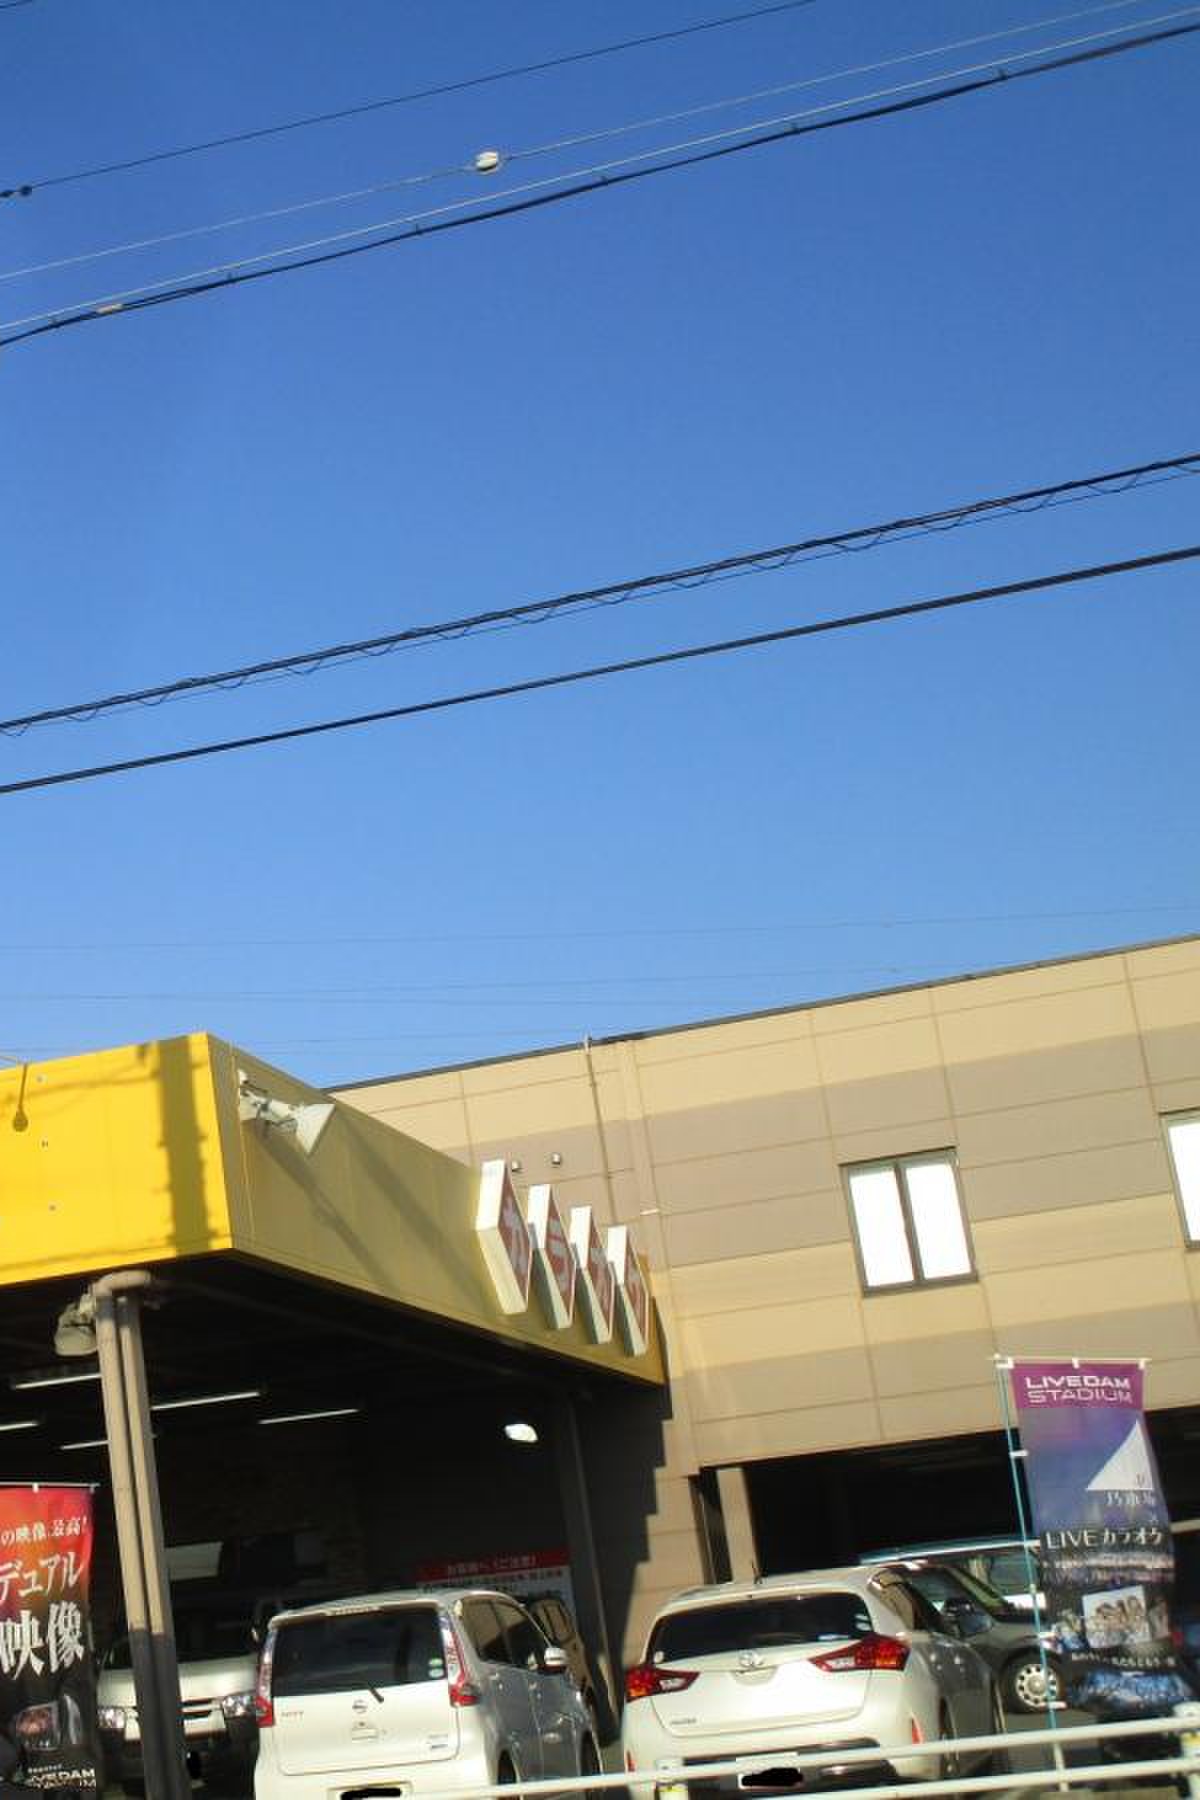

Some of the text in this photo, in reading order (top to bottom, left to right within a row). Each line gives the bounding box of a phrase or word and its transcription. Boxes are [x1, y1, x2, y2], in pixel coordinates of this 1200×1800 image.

[1027, 1388, 1133, 1404] STADIUM
[1045, 1526, 1163, 1550] LIVE カラオケ
